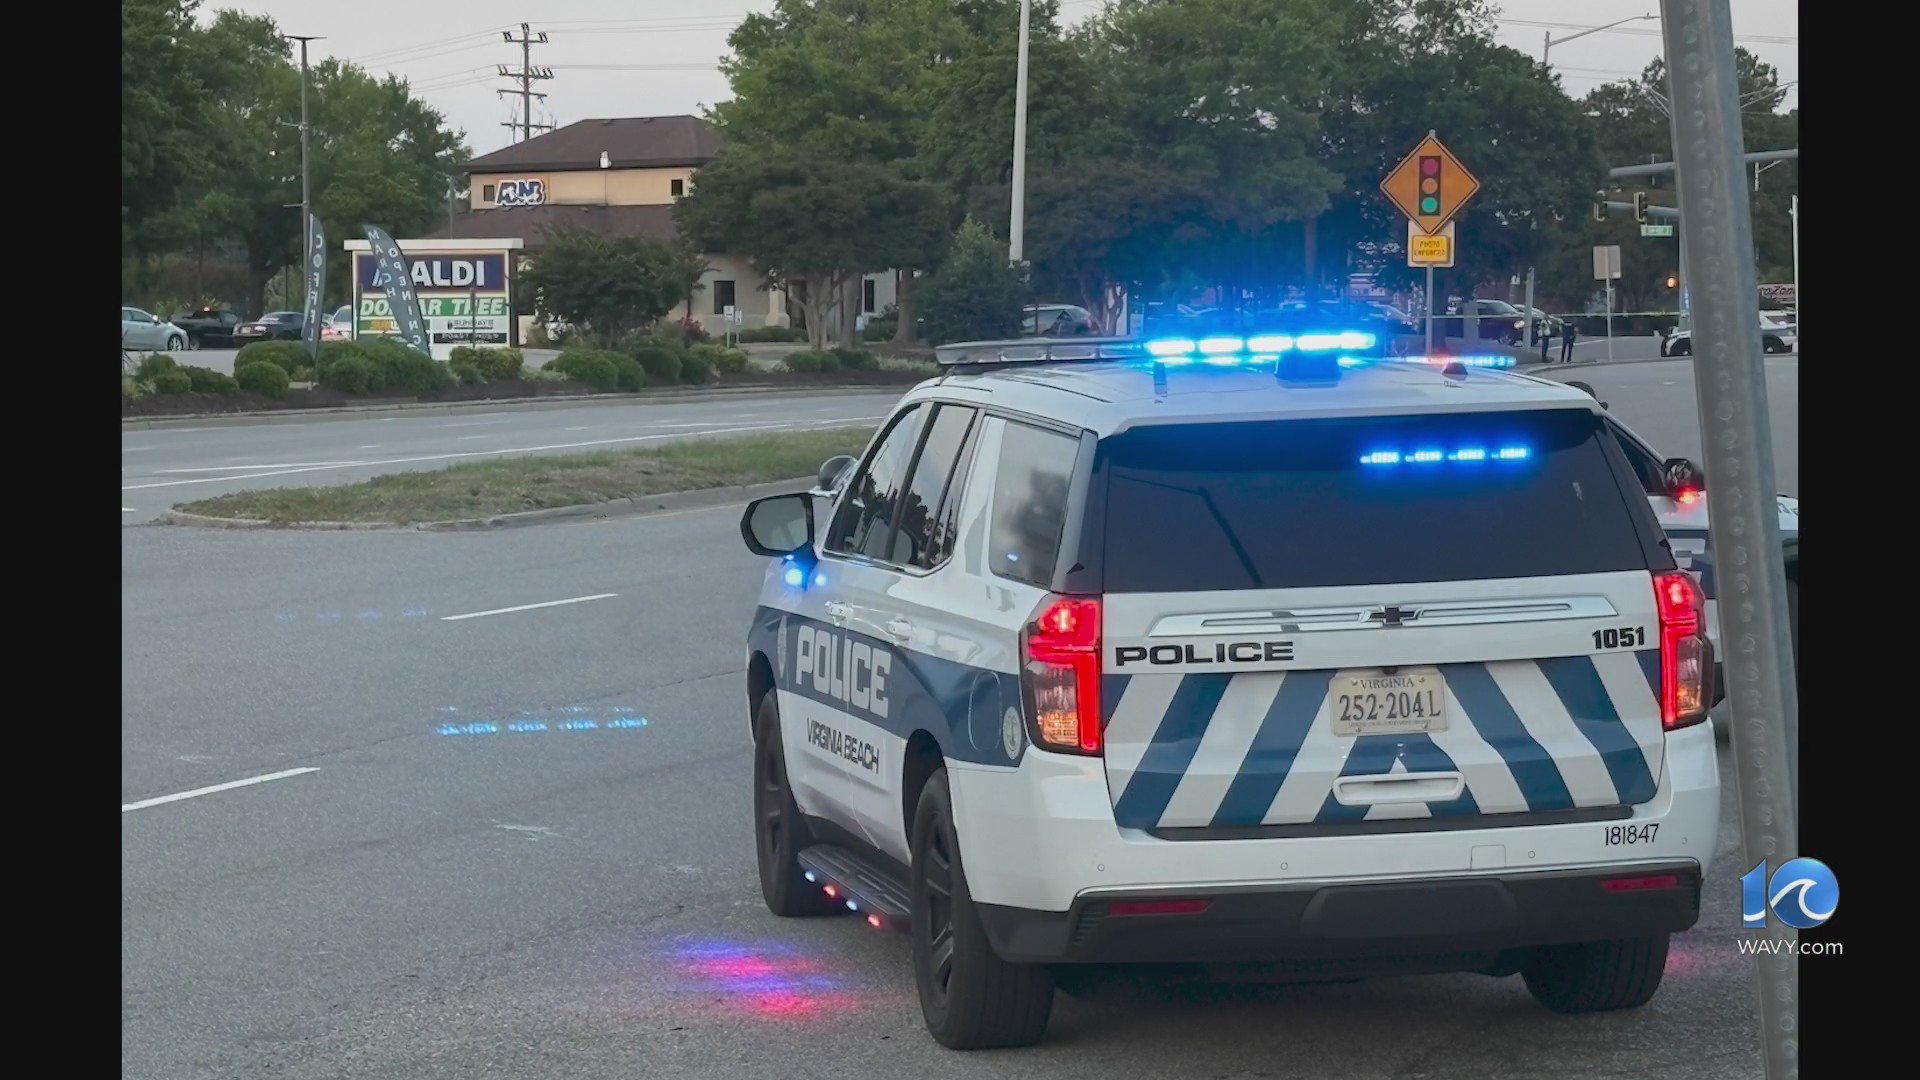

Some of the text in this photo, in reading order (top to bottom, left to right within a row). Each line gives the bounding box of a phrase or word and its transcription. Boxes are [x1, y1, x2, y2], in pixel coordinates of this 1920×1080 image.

[411, 260, 485, 286] ALDI
[361, 299, 443, 316] DOAR
[1592, 626, 1645, 649] 1051
[1115, 641, 1294, 666] POLICE
[795, 625, 892, 718] POLICE
[1360, 678, 1415, 689] VIRGINIA
[807, 717, 880, 775] VIRGINIA BEACH
[1605, 823, 1659, 846] 181847
